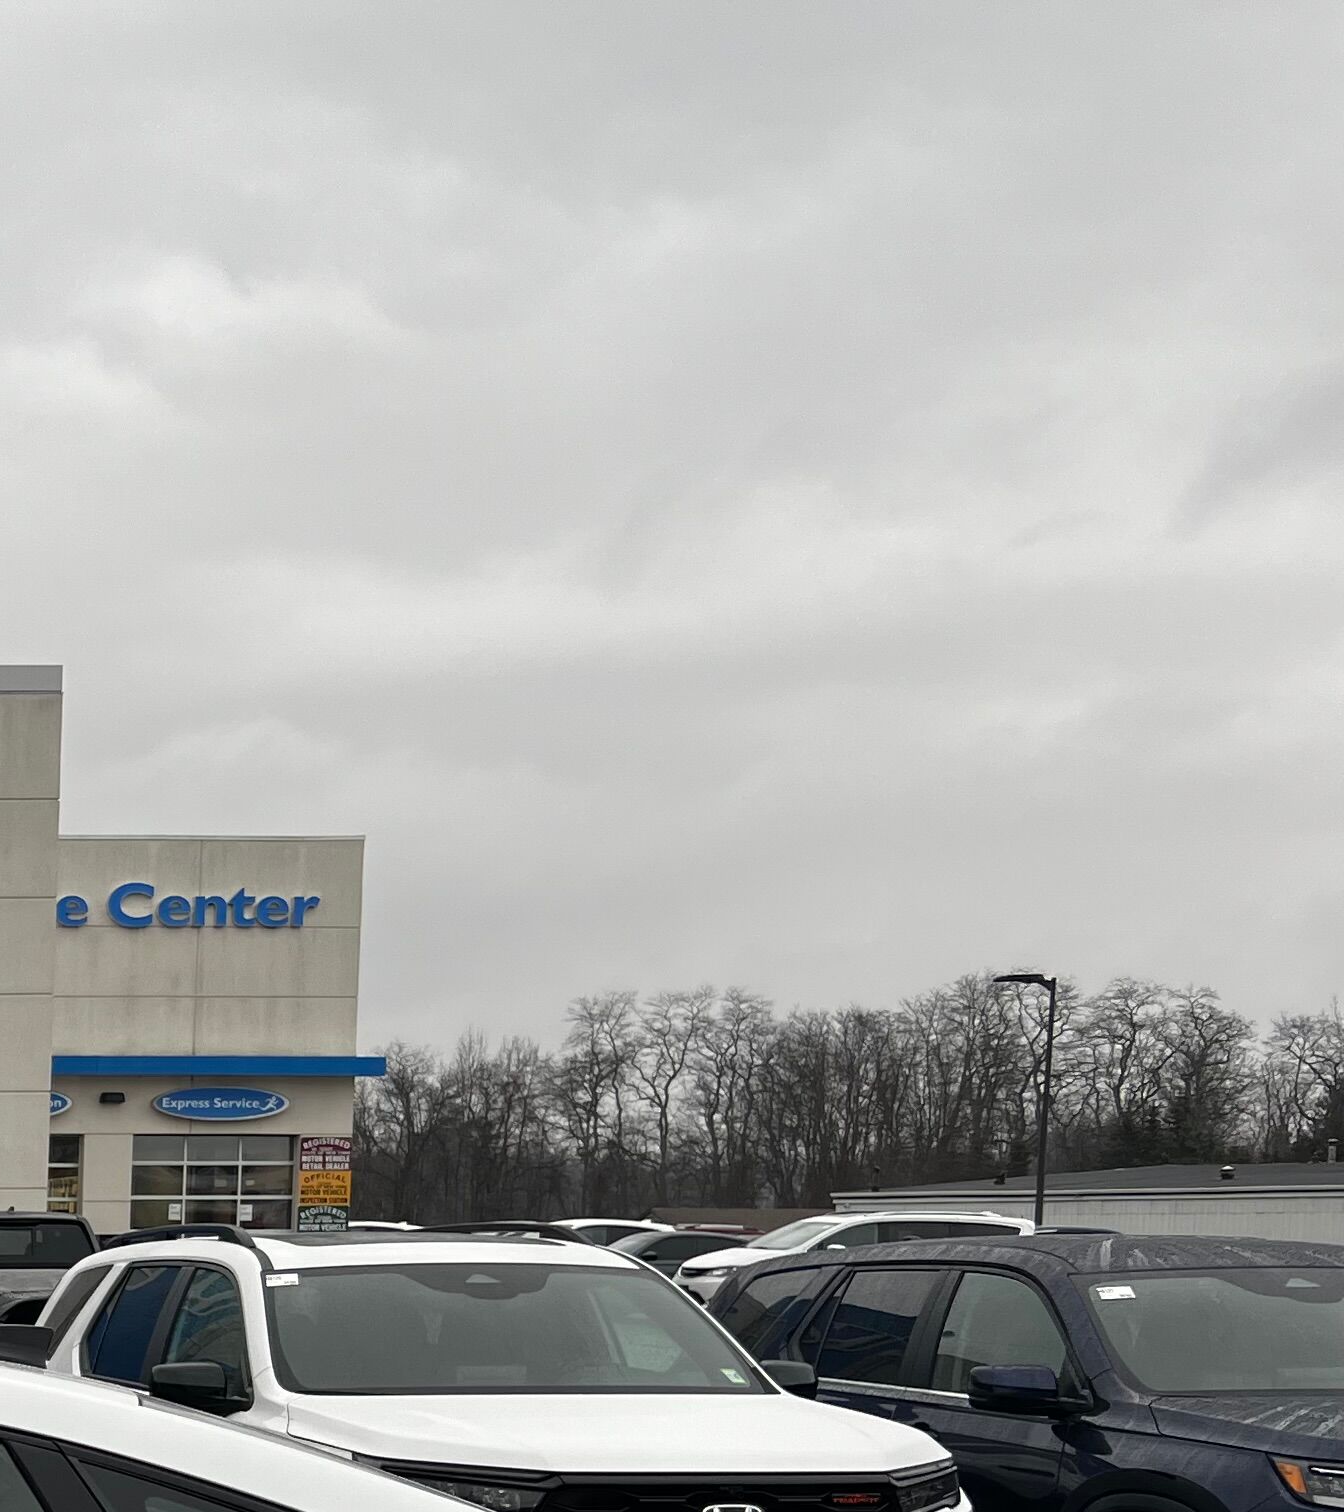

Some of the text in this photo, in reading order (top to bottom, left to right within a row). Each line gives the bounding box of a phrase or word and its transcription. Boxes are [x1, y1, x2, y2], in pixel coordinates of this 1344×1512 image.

[107, 882, 321, 929] Center
[162, 1098, 261, 1110] Express Service
[302, 1137, 351, 1150] REGISTERED
[303, 1172, 346, 1184] OFFICIAL
[300, 1206, 347, 1219] REGISTERED
